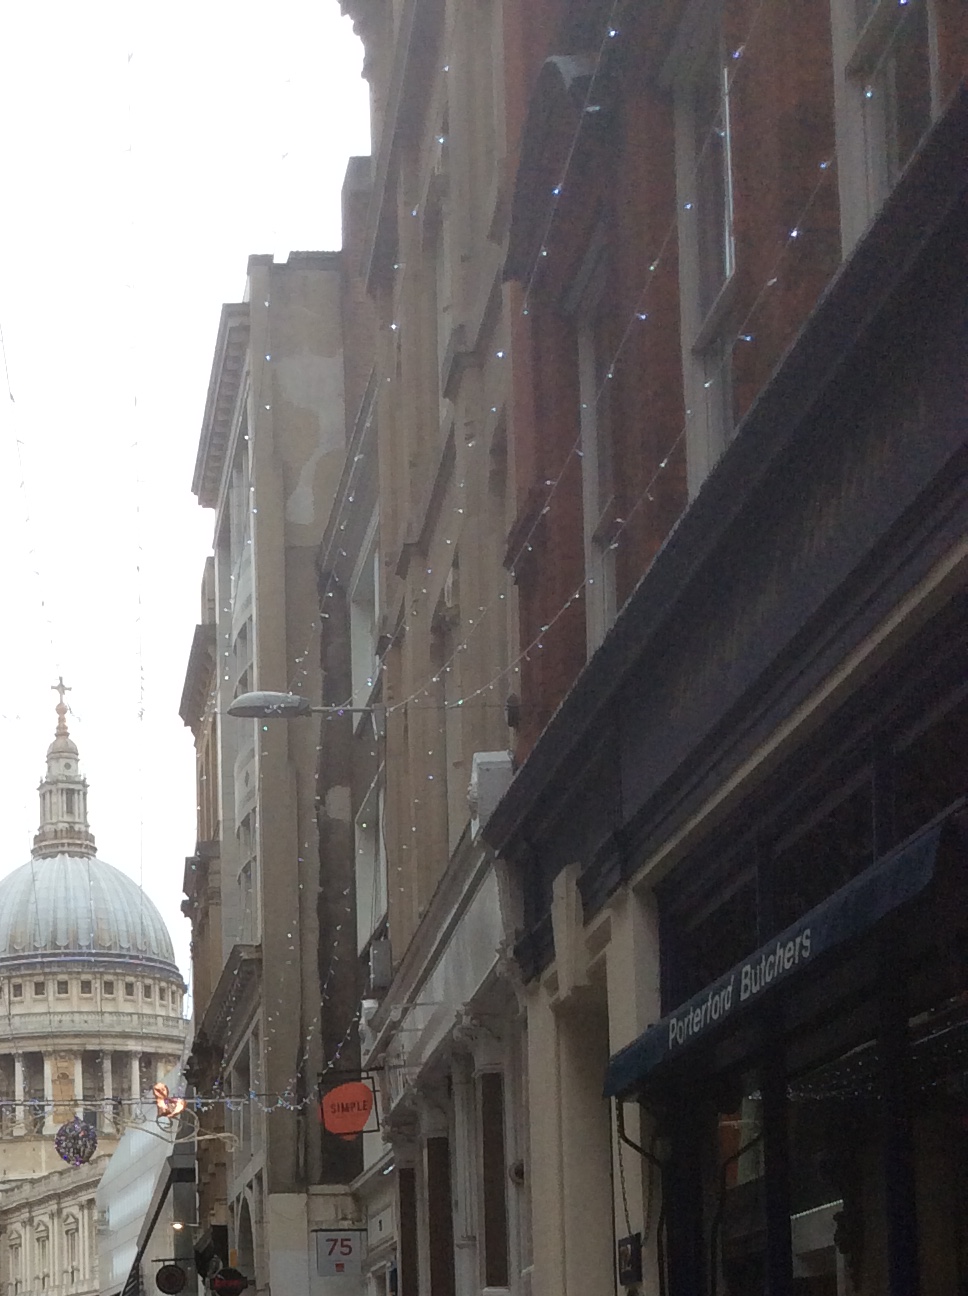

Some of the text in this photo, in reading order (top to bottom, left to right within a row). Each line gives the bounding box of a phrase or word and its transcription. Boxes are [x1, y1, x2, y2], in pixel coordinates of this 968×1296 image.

[668, 928, 811, 1050] Porterford Butchers
[330, 1099, 369, 1114] SIMPLE
[325, 1237, 353, 1256] 75
